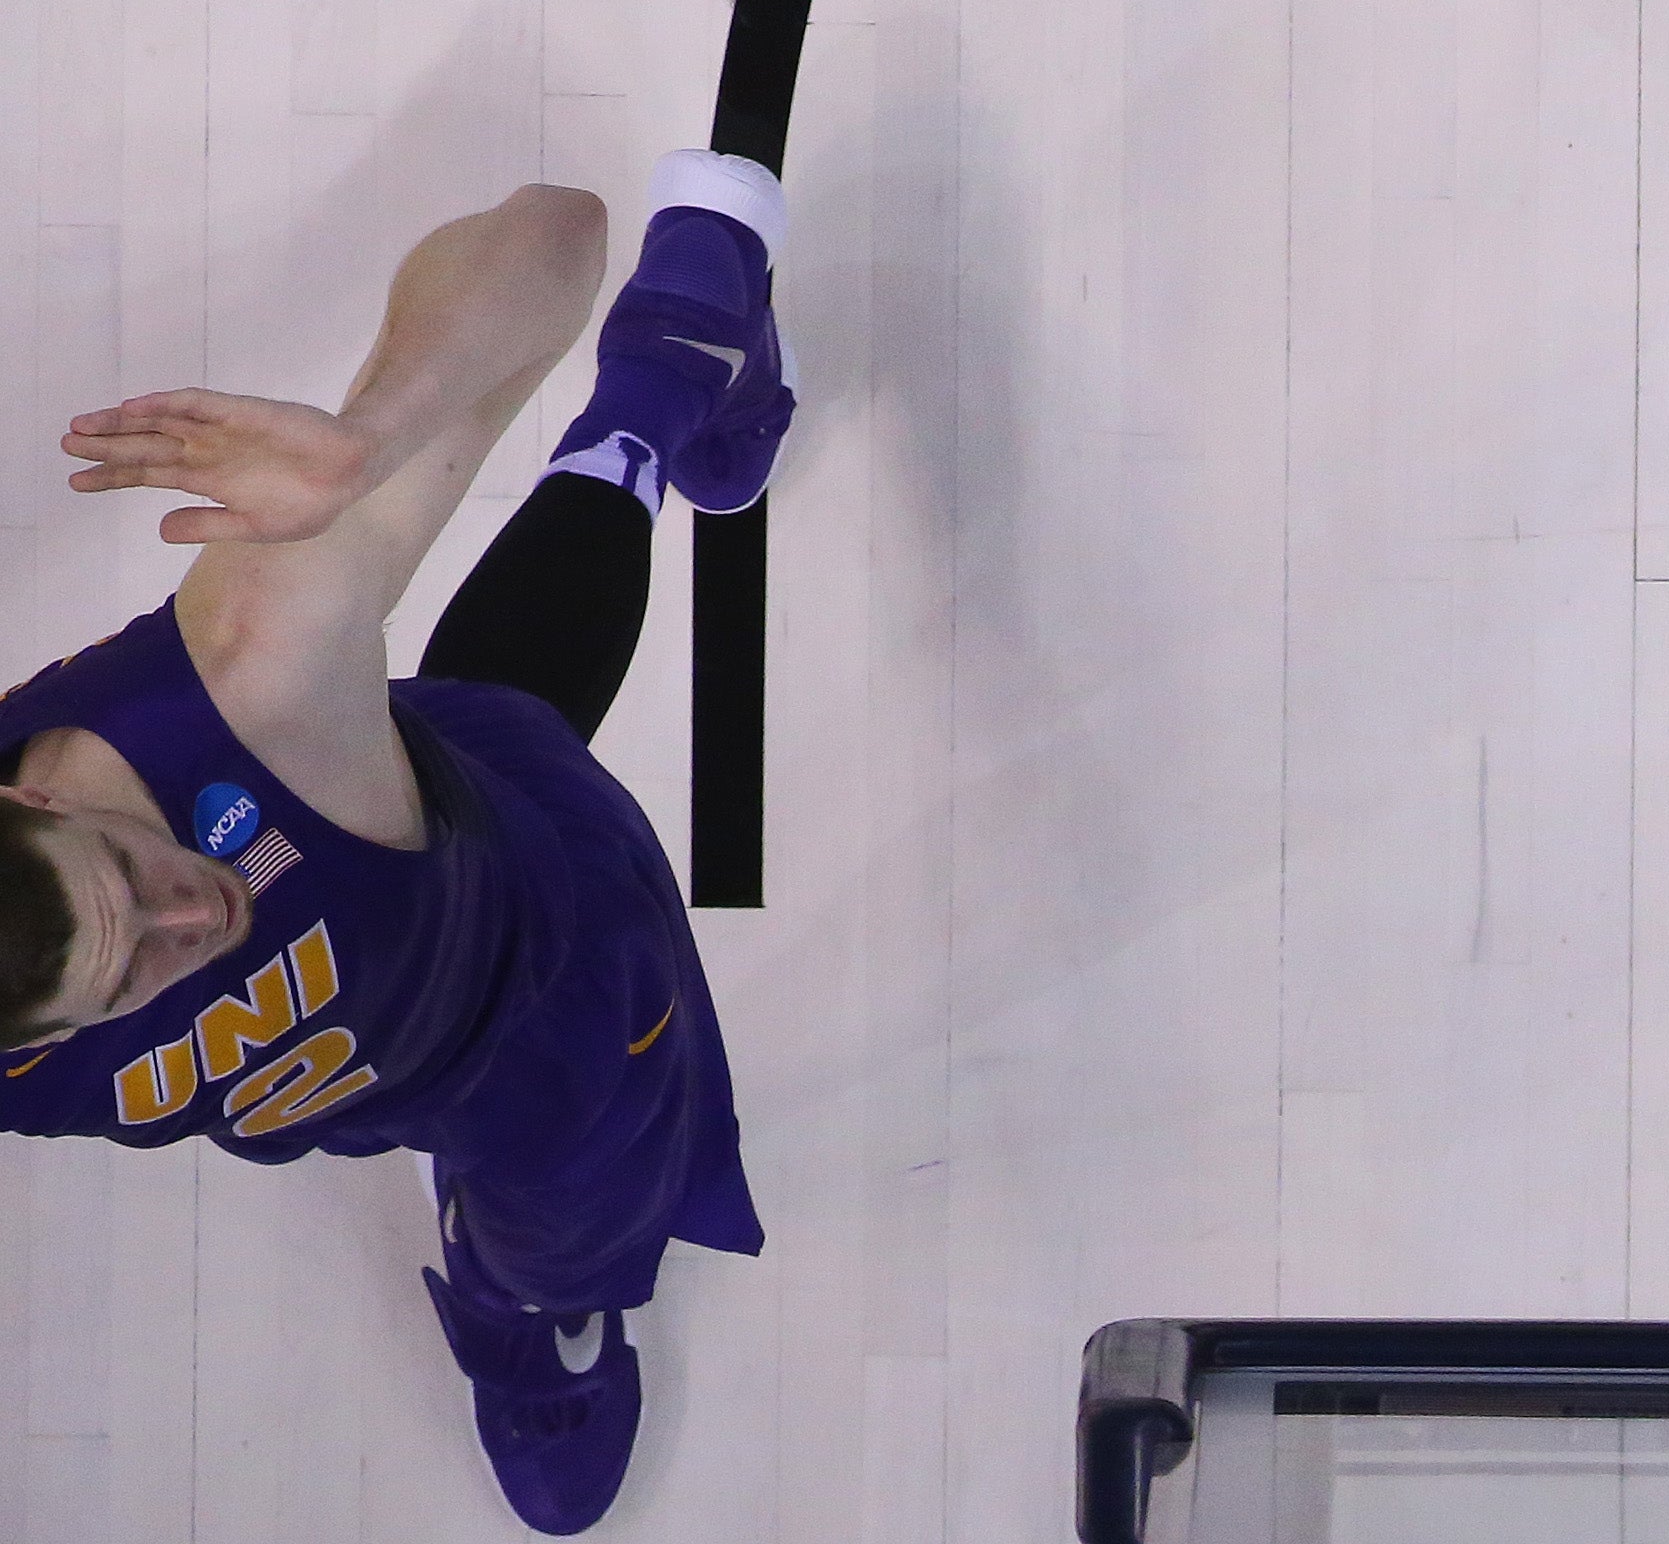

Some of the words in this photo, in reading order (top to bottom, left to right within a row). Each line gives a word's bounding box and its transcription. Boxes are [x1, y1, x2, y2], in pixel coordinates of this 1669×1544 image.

[207, 796, 256, 851] NCAA
[113, 917, 341, 1127] UNI
[222, 1025, 380, 1139] 2
